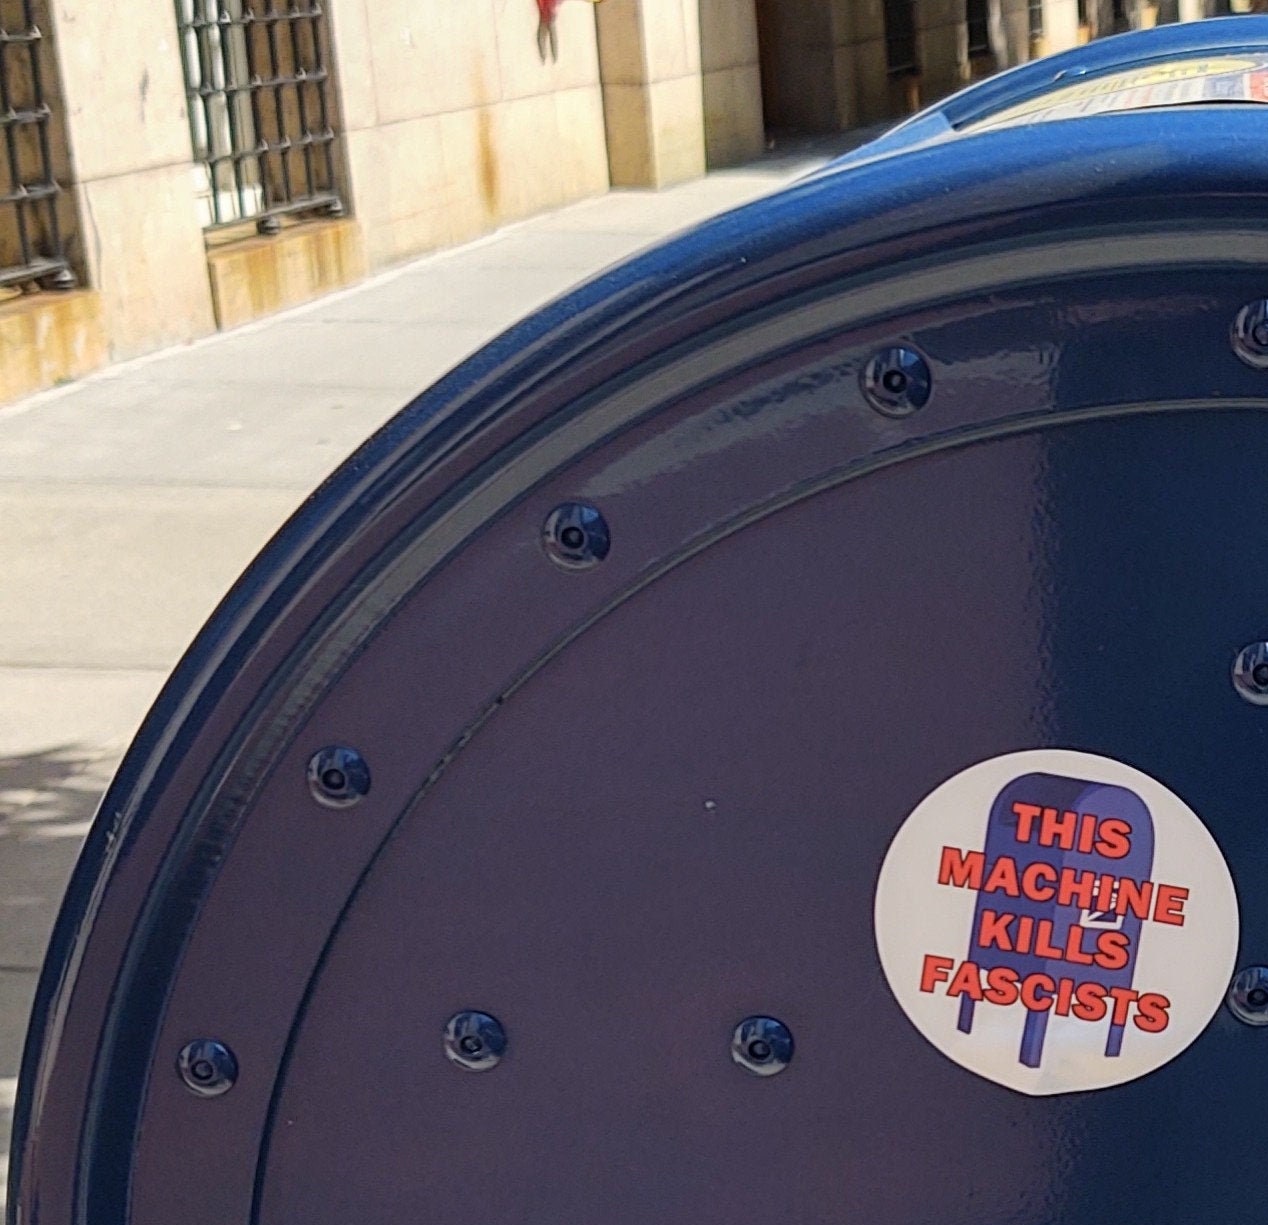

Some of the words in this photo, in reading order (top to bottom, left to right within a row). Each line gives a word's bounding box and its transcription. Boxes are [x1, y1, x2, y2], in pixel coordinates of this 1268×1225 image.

[1011, 802, 1133, 860] THIS
[937, 845, 1190, 927] MACHINE
[977, 909, 1131, 970] KILLS
[919, 954, 1172, 1033] FASCISTS
